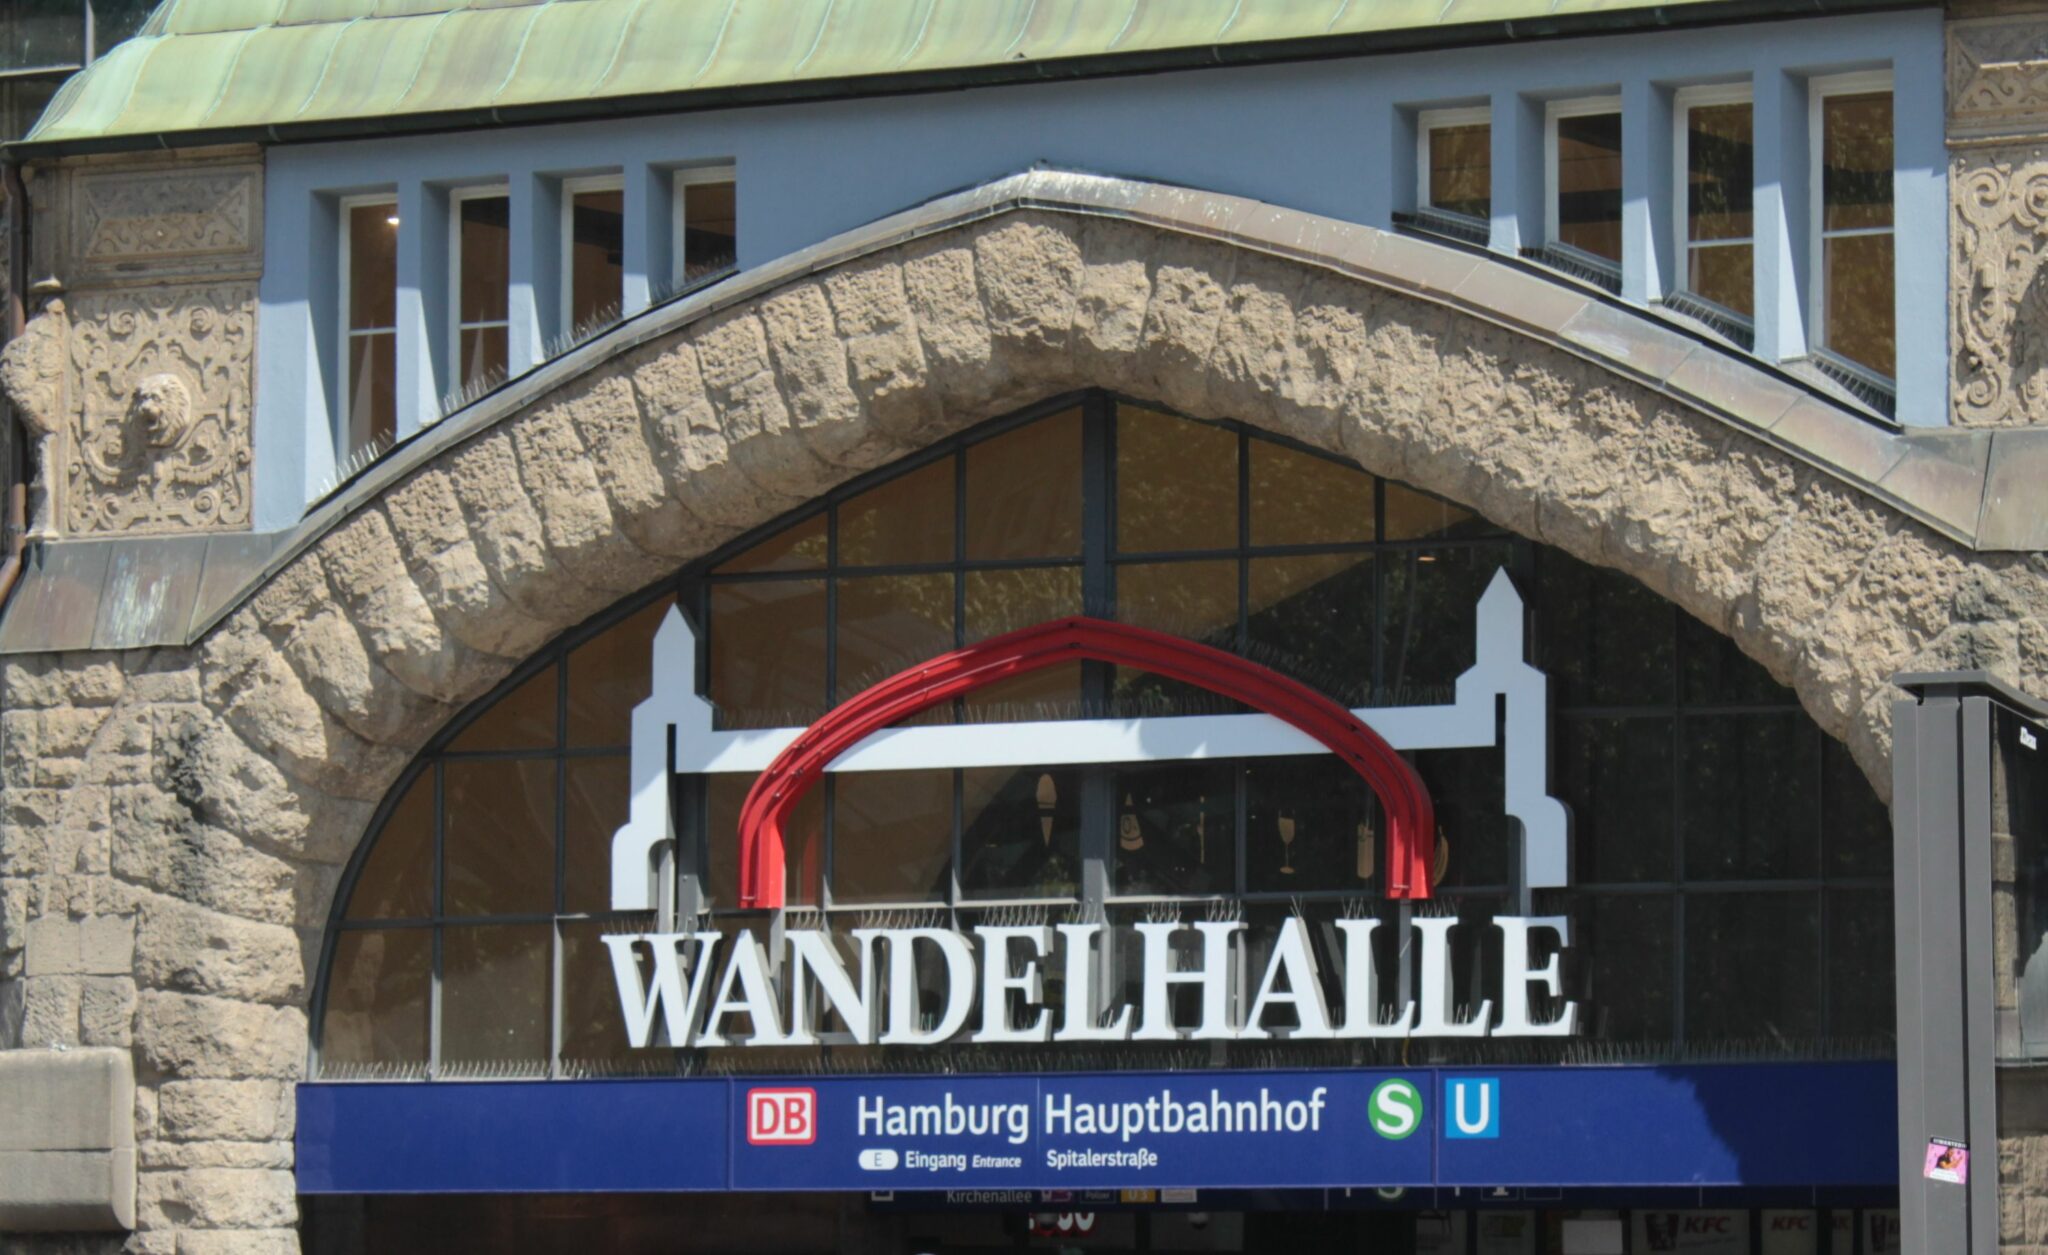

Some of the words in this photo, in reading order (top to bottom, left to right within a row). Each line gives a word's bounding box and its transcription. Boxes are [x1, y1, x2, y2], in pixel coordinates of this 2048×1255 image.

[601, 914, 1577, 1048] WANDELHALLE
[756, 1097, 808, 1135] DB
[858, 1092, 1029, 1144] Hamburg
[1045, 1086, 1327, 1142] Hauptbahnhof
[1376, 1084, 1415, 1134] S
[1455, 1083, 1490, 1134] U
[905, 1150, 967, 1171] Eingang
[972, 1154, 1022, 1168] Entrance
[1046, 1147, 1158, 1170] Spitalerstraße
[946, 1190, 1032, 1203] Kirchenallee
[1684, 1216, 1730, 1233] KFC
